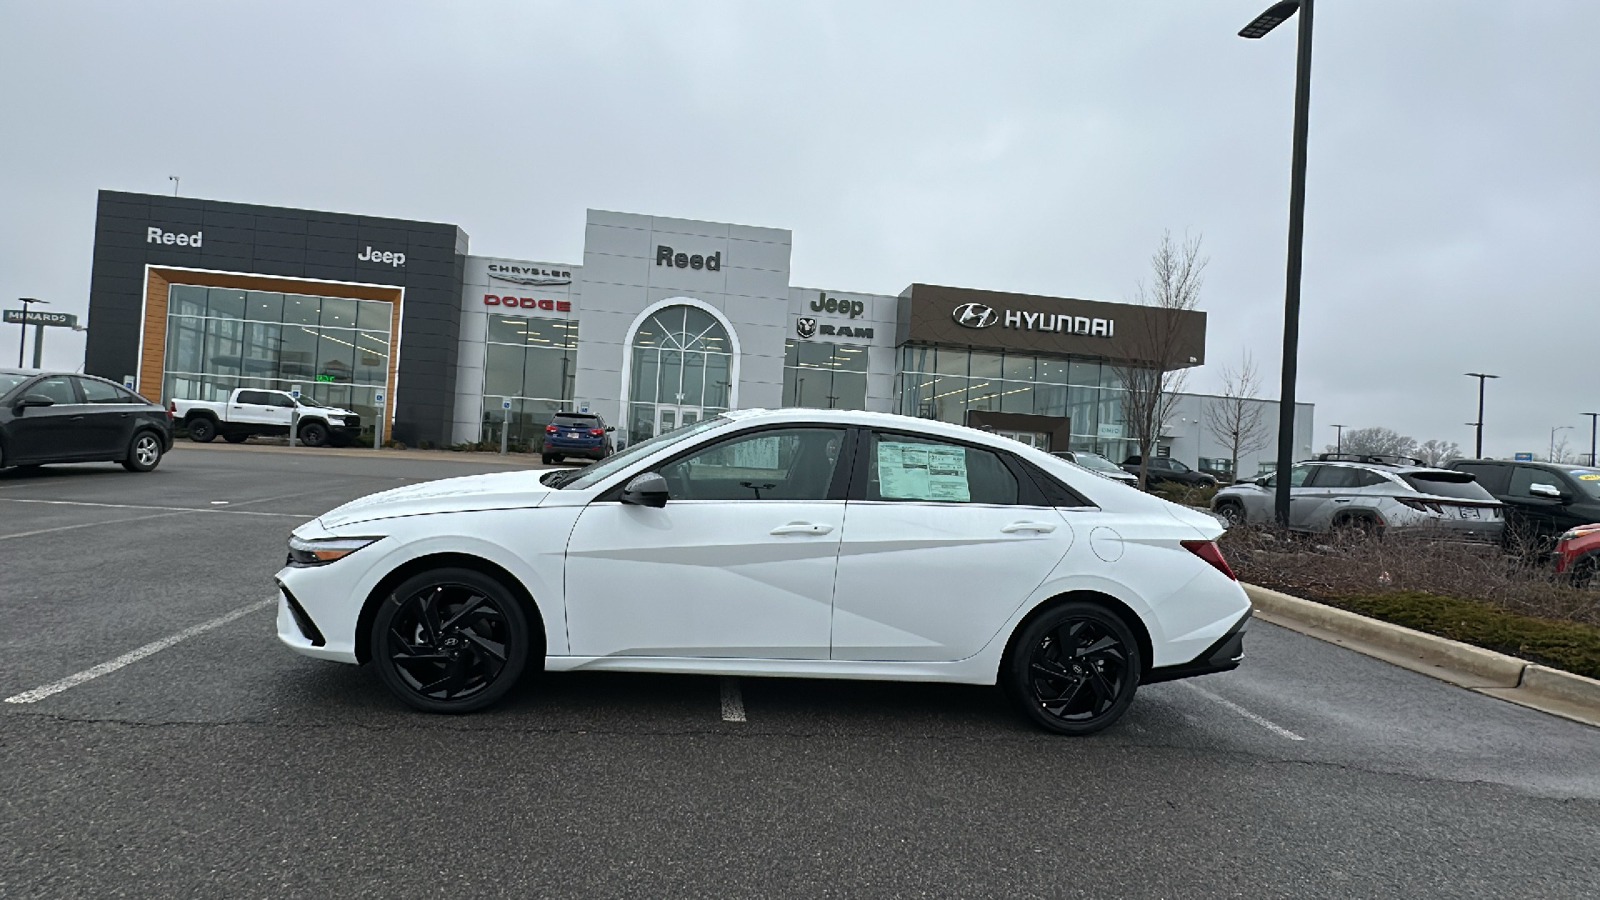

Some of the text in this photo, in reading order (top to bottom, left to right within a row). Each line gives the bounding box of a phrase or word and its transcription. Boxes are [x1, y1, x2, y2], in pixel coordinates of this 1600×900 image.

[147, 226, 203, 248] Reed
[357, 245, 406, 268] Jeep
[656, 244, 721, 271] Reed
[488, 264, 571, 279] CHRYSLER
[484, 294, 571, 312] DODGE
[810, 292, 864, 319] Jeep
[819, 324, 874, 339] RAM
[1003, 309, 1115, 338] HYUNDAI
